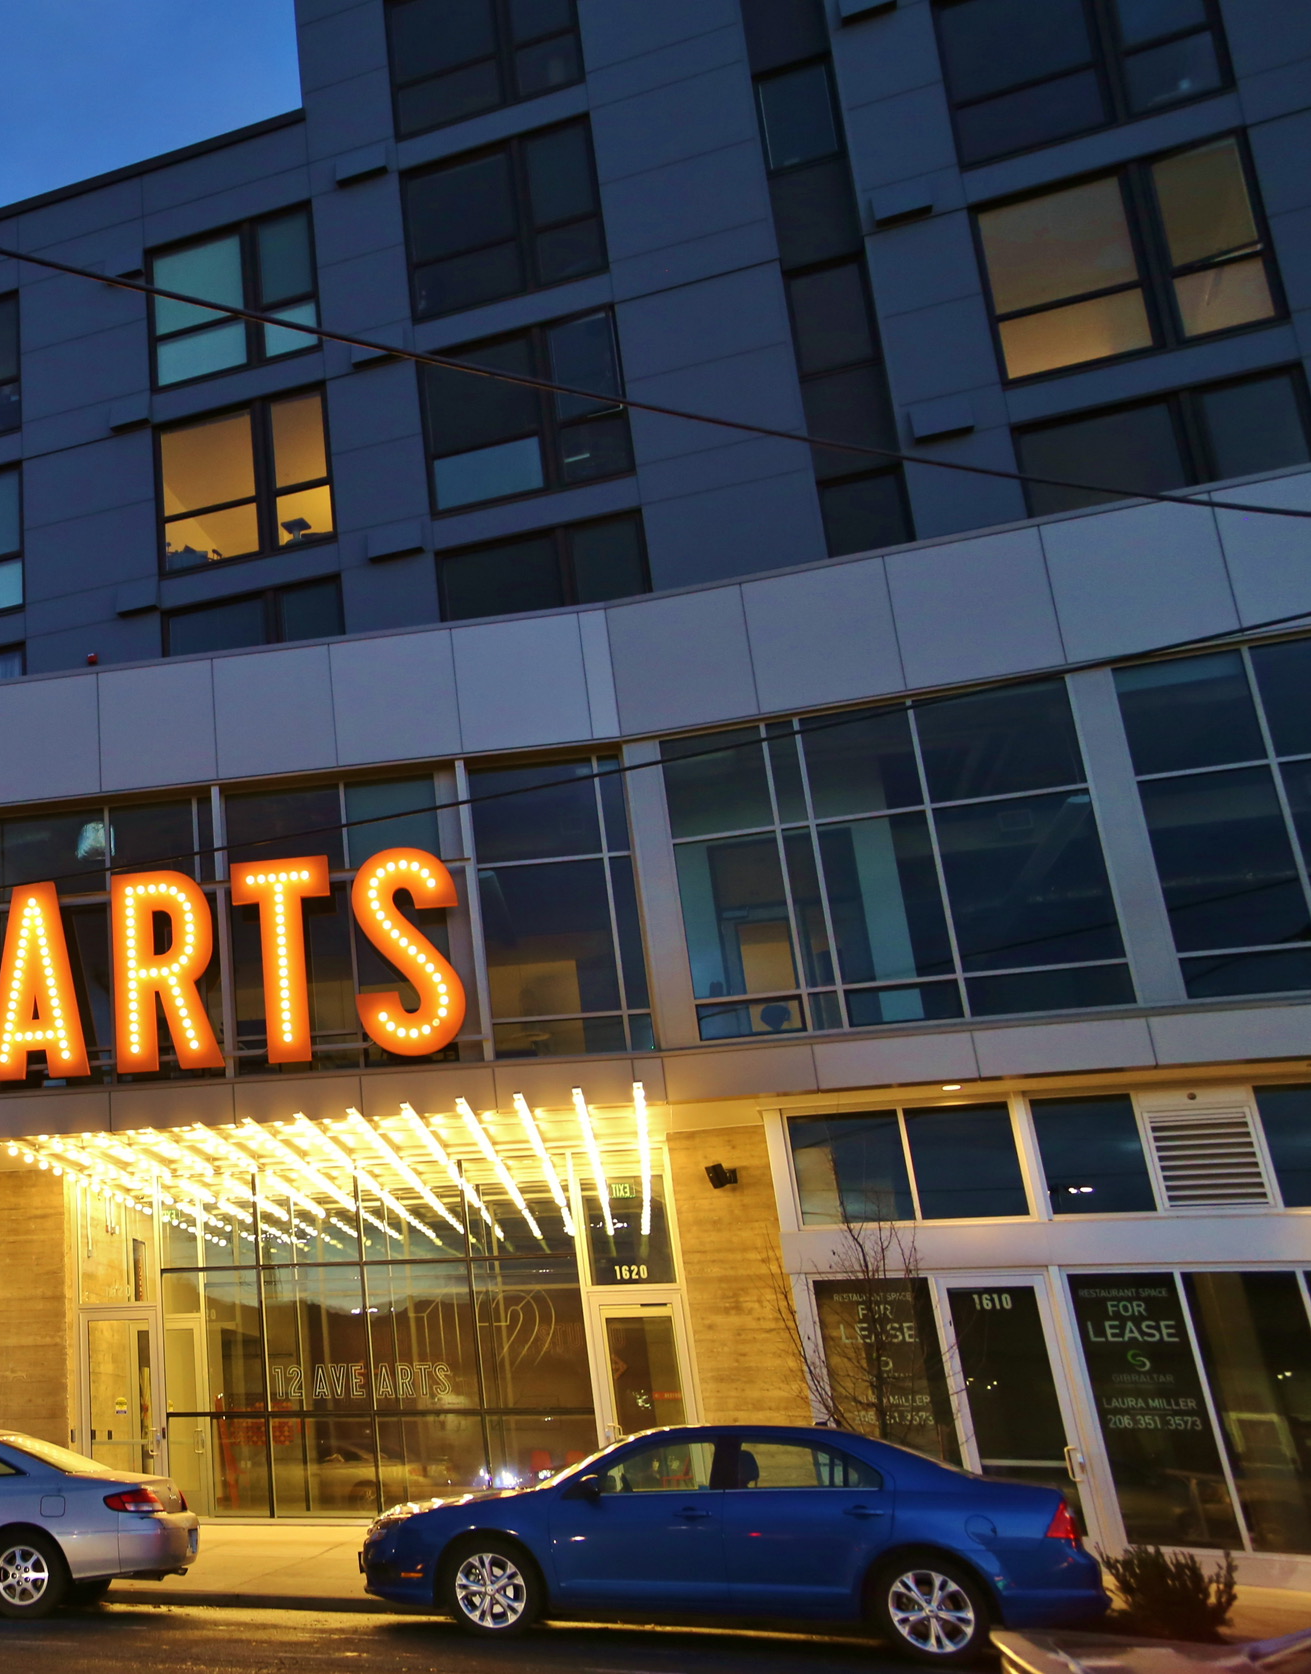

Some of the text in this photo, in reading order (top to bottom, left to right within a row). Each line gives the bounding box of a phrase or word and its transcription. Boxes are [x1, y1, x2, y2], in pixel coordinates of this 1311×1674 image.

[615, 1264, 648, 1280] 1620
[1078, 1287, 1168, 1298] RESTAURANT SPACE
[972, 1293, 1013, 1310] 1610
[1107, 1301, 1147, 1316] FOR
[1087, 1321, 1180, 1342] LEASE
[272, 1362, 453, 1399] 12 AVE ARTS
[1112, 1373, 1175, 1384] GIBRALTAR
[1103, 1397, 1198, 1410] LAURA MILLER
[1107, 1415, 1203, 1430] 206.351.3573
